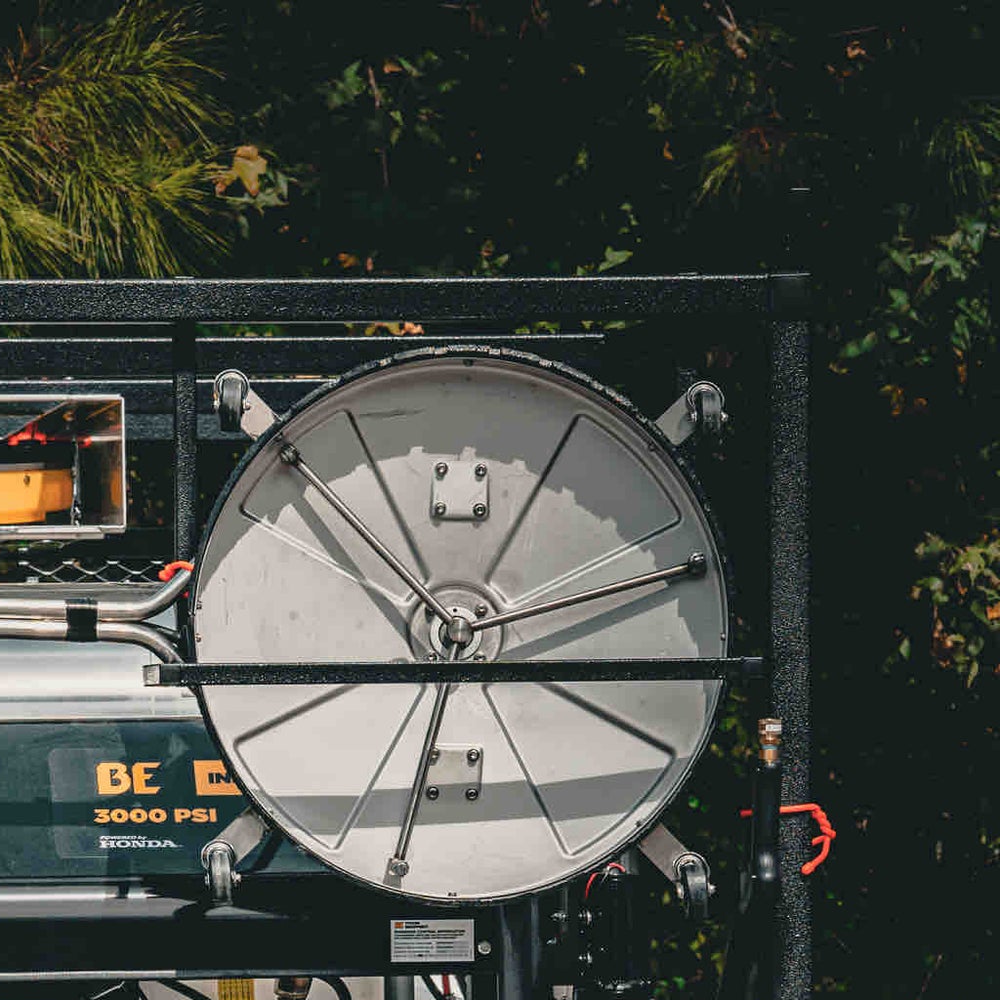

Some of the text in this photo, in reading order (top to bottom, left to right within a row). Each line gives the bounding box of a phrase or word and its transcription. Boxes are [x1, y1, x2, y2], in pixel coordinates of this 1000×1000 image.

[96, 762, 161, 795] BE
[94, 808, 217, 823] 3000 PSI
[99, 840, 178, 849] HONDA
